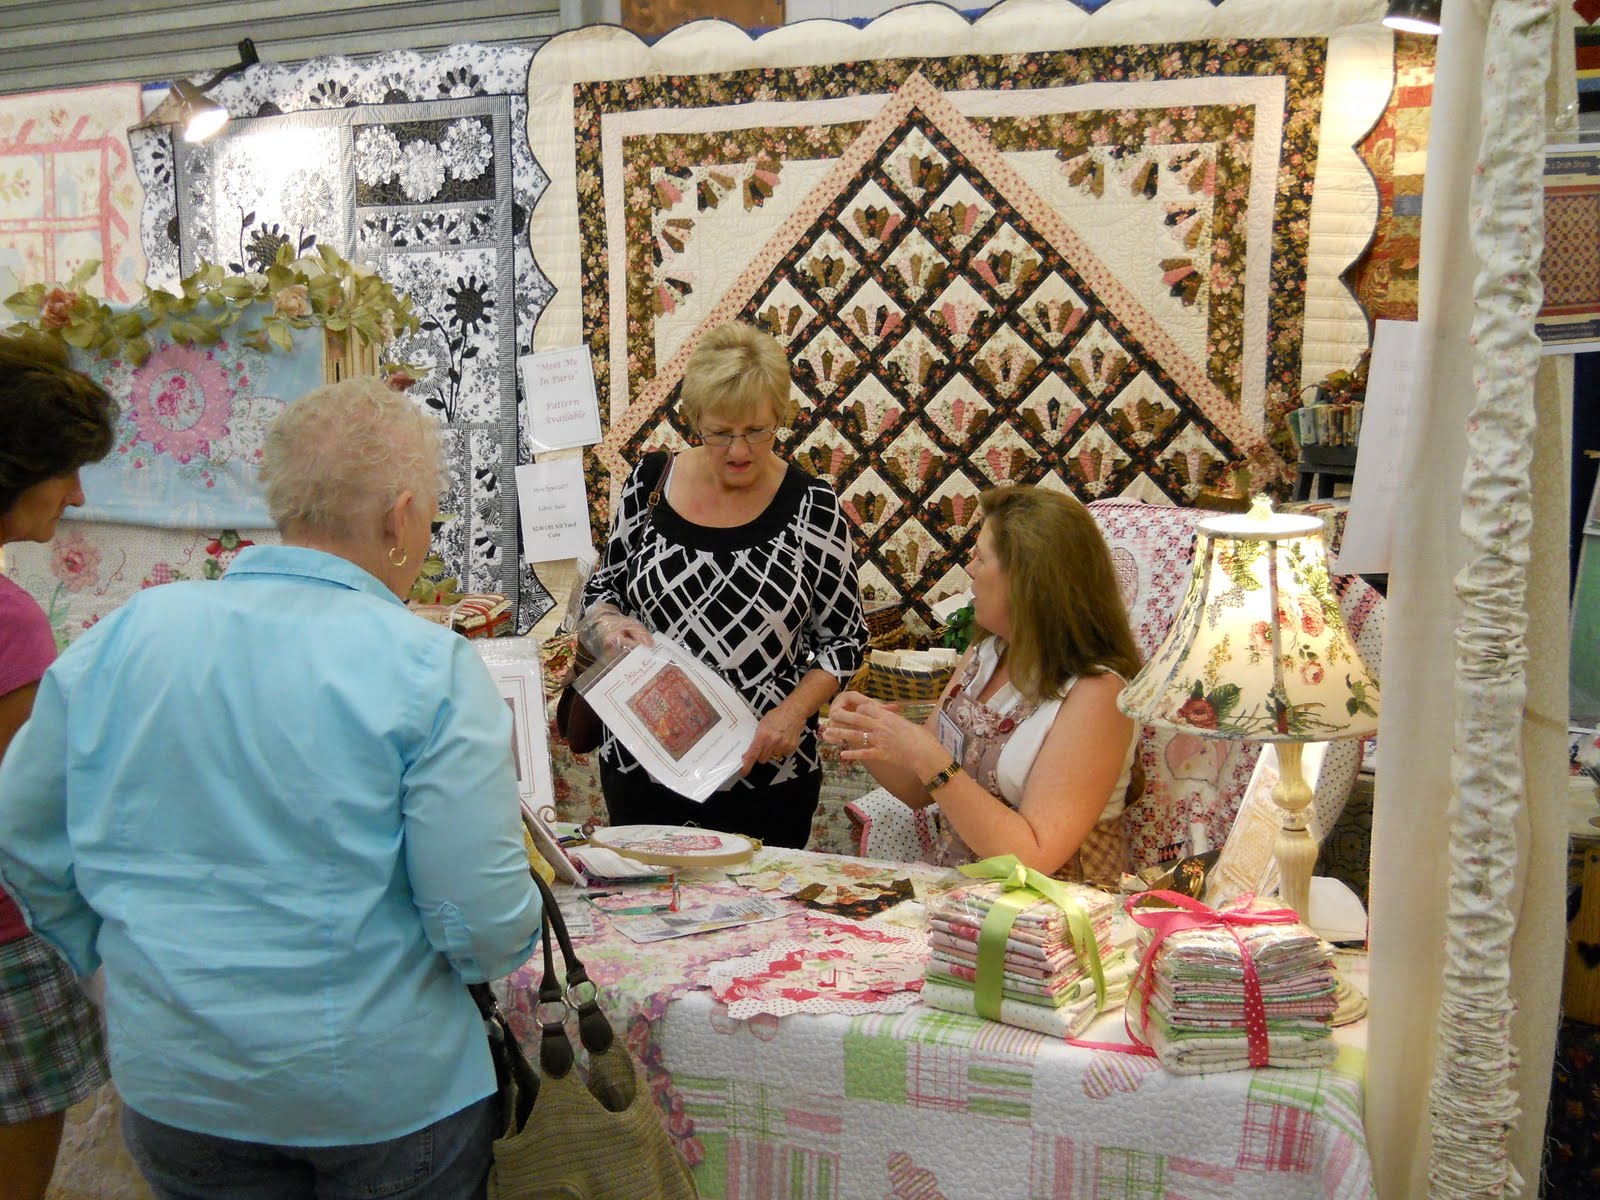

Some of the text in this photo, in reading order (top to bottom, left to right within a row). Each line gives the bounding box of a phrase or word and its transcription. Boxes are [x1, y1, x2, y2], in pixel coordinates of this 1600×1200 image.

[564, 358, 577, 367] Me
[540, 377, 549, 386] In
[545, 399, 580, 410] Pattern
[544, 411, 586, 424] Available
[554, 503, 566, 511] Sale
